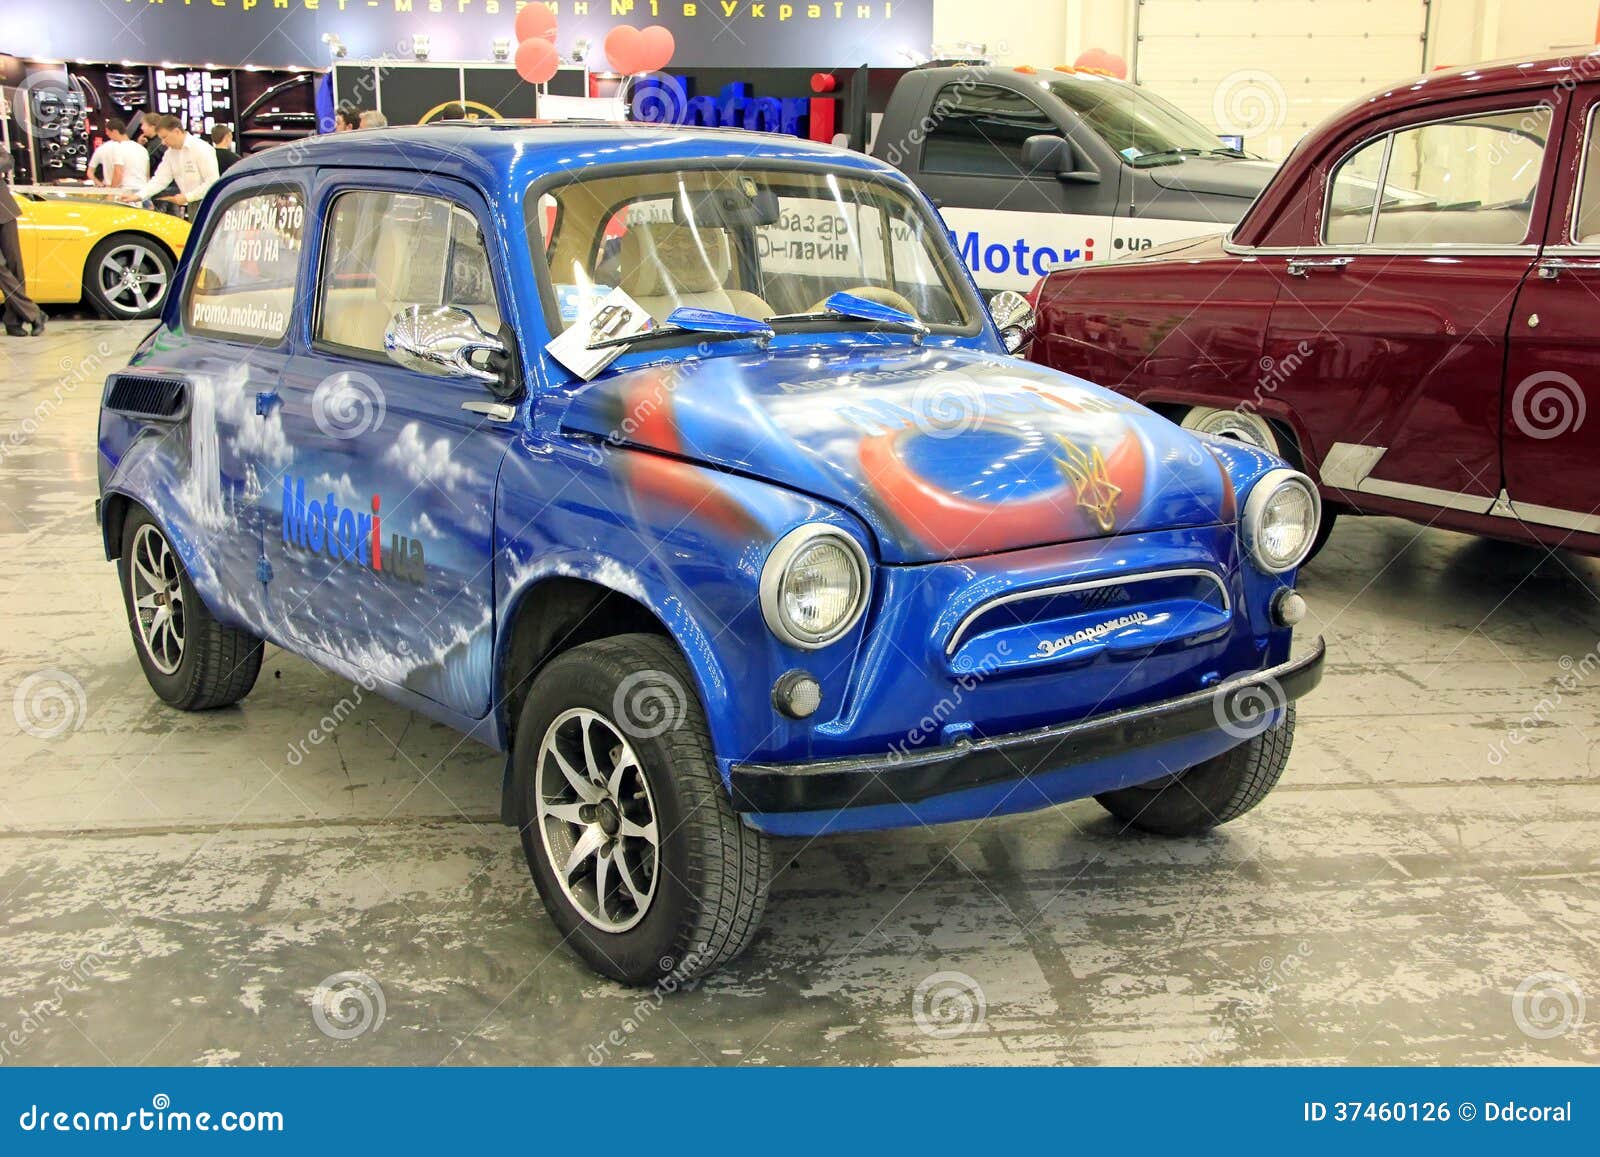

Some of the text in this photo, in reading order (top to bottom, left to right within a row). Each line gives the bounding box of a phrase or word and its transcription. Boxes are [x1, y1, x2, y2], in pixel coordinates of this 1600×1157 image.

[721, 1, 892, 19] Україні
[224, 200, 303, 231] ВЫИГРАЙ ЭТО
[233, 240, 279, 261] АВТО НА
[193, 303, 284, 331] promo.motori.ua
